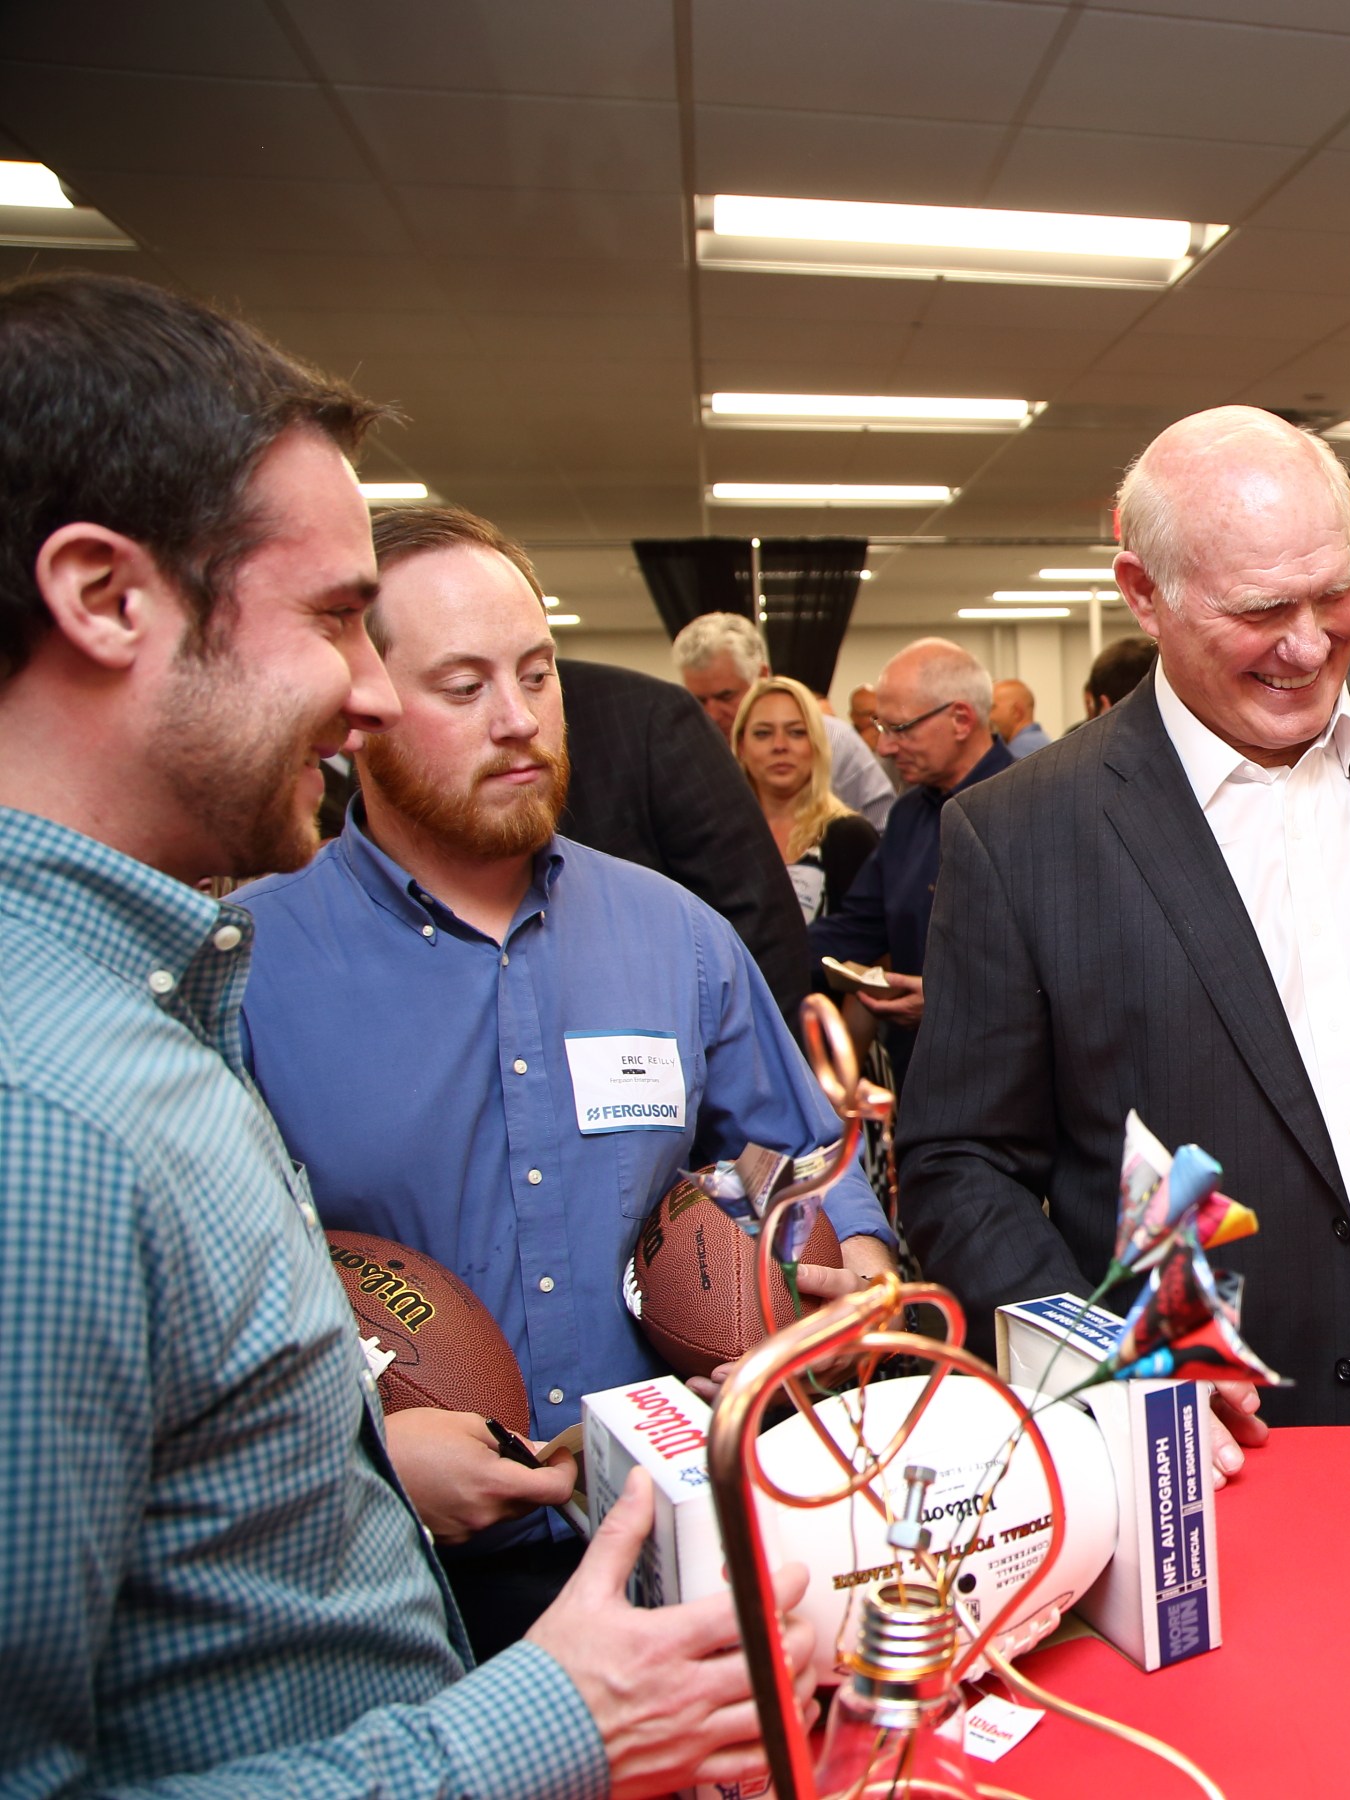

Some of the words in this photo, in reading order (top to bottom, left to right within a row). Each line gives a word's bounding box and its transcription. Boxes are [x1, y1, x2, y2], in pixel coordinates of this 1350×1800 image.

[621, 1055, 644, 1065] ERIC
[602, 1104, 678, 1119] FERGUSON
[695, 1224, 711, 1291] OFFICIAL
[329, 1245, 436, 1334] Wilson
[625, 1385, 708, 1460] Wilson
[1182, 1405, 1195, 1478] SIGNATURES
[1156, 1436, 1176, 1546] AUTOGRAPH
[1187, 1480, 1197, 1501] FOR
[1000, 1514, 1053, 1545] TIONAL
[1163, 1550, 1177, 1587] NFL
[1191, 1526, 1201, 1578] OFFICIAL
[833, 1561, 904, 1589] LEAGUE
[995, 1570, 1032, 1589] RICAN
[1167, 1603, 1182, 1658] MORE
[1180, 1597, 1200, 1655] WIN
[968, 1715, 1013, 1741] Wilson
